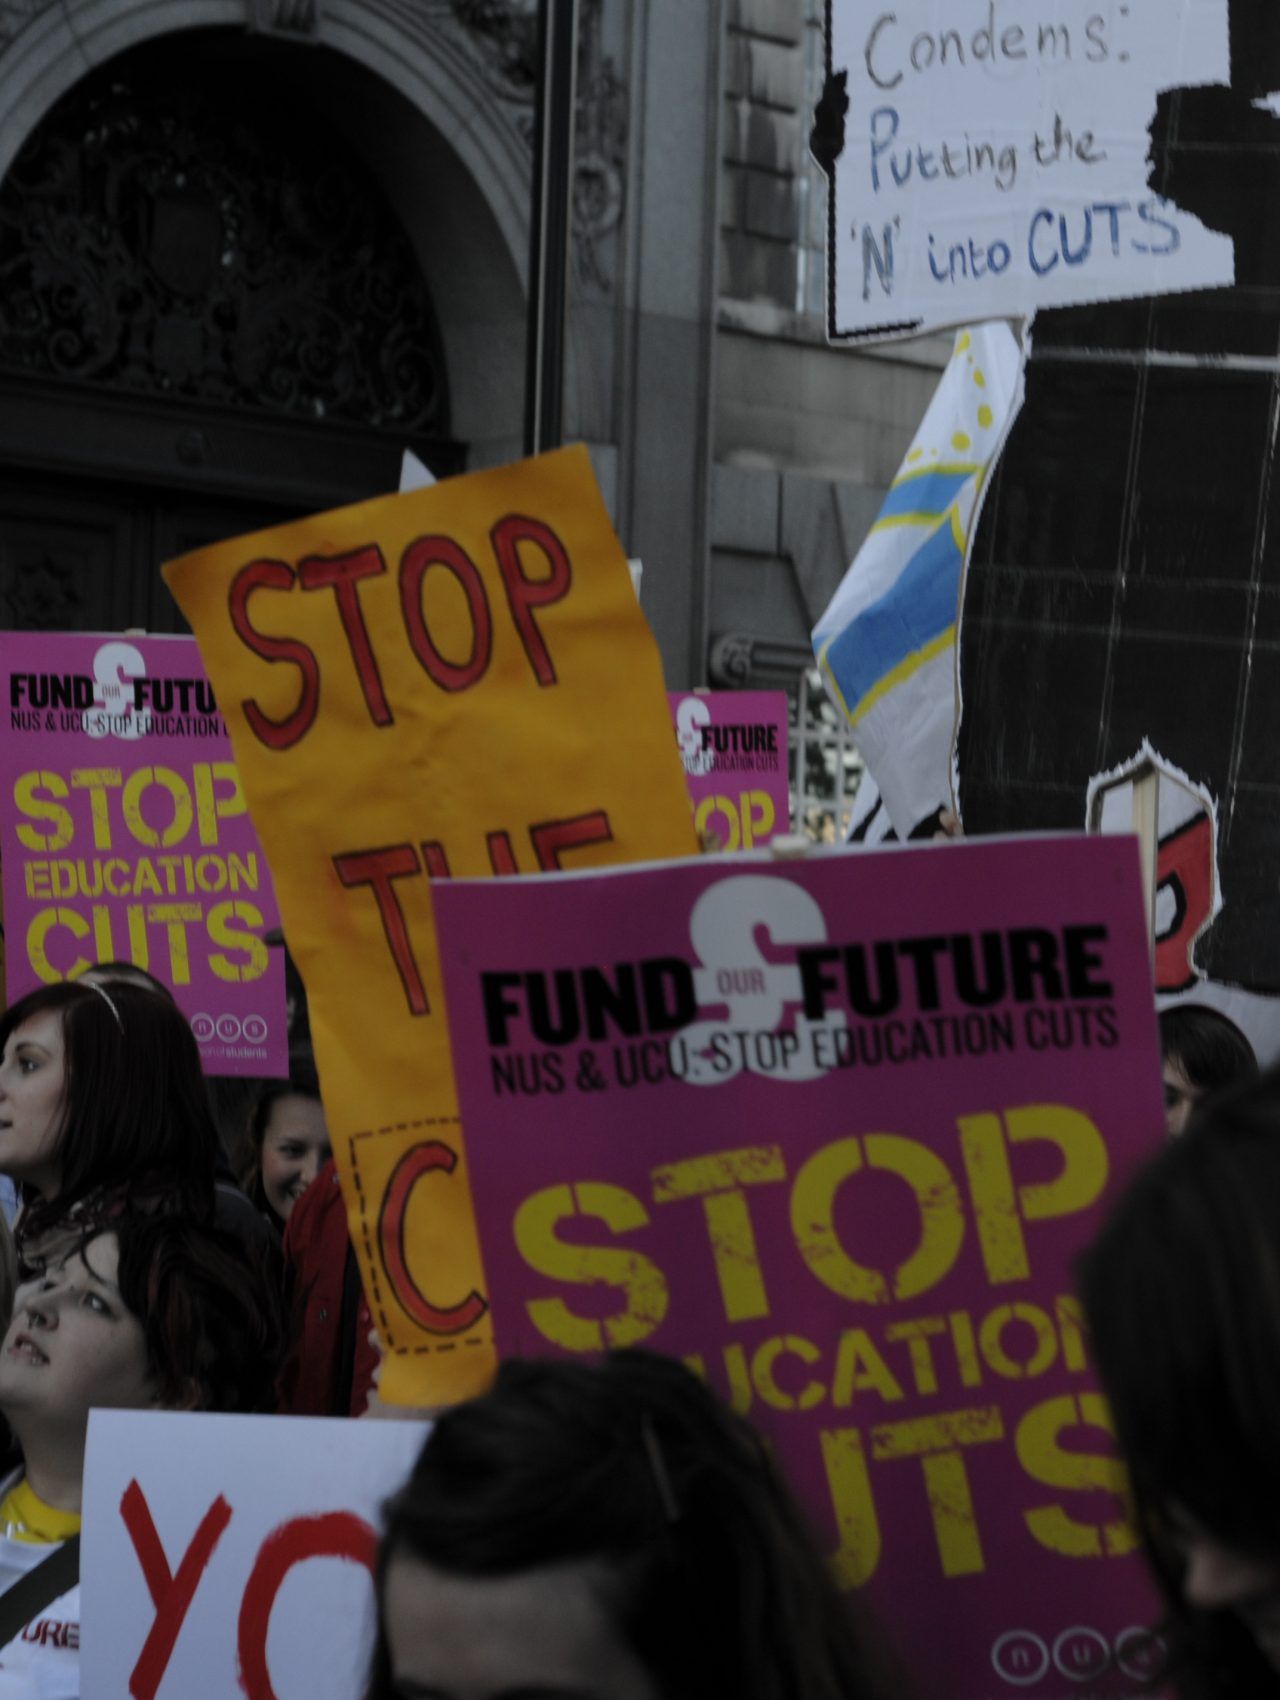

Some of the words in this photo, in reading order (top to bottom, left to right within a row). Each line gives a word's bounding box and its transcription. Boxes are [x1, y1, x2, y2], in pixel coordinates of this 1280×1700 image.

[869, 106, 1018, 194] Putting
[1034, 112, 1107, 166] the
[928, 233, 1012, 283] into
[1028, 200, 1182, 276] CUTS
[229, 513, 573, 751] STOP
[10, 673, 94, 709] FUND
[133, 678, 217, 714] FUTU
[11, 711, 40, 731] NUS
[45, 712, 55, 731] &
[97, 714, 132, 734] STOP
[136, 715, 219, 738] EDUCATION
[701, 724, 778, 754] FUTURE
[13, 762, 248, 852] STOP
[695, 789, 776, 852] OP
[24, 852, 259, 899] EDUCATION
[26, 899, 269, 986] CUTS
[480, 955, 698, 1047] FUND
[716, 968, 766, 997] OUR
[797, 924, 1115, 1021] FUTURE
[489, 1053, 566, 1098] NUS
[576, 1049, 608, 1093] &
[709, 1027, 801, 1074] STOP
[812, 1011, 1015, 1072] EDUCATION
[1023, 1004, 1119, 1050] CUTS
[512, 1104, 1110, 1353] STOP
